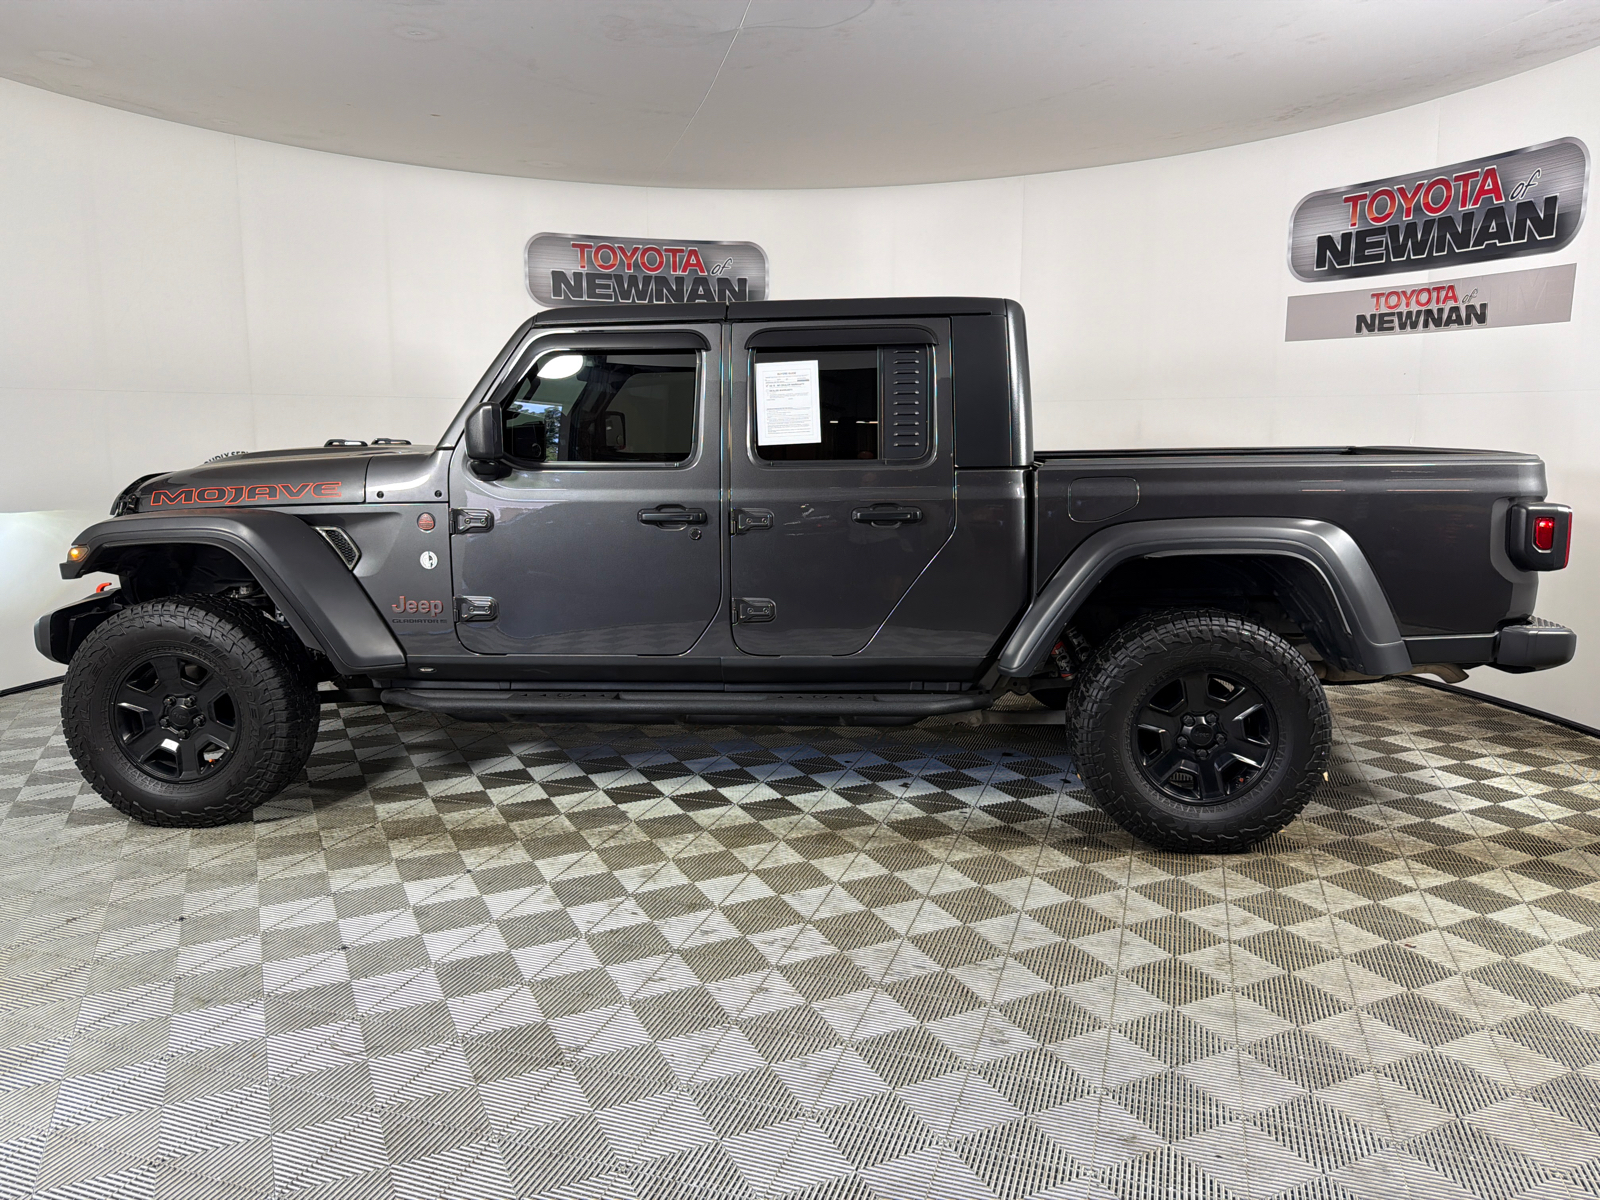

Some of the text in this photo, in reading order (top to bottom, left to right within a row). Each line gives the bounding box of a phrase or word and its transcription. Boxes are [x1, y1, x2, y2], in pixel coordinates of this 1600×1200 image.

[1343, 165, 1542, 228] TOYOTA of
[1314, 193, 1559, 271] NEWNAN
[570, 242, 733, 276] TOYOTA of
[550, 269, 749, 303] NEWNAN
[1370, 284, 1478, 311] TOYOTA of
[1354, 302, 1488, 335] NEWNAN
[150, 481, 342, 506] MOJAVE
[391, 595, 444, 618] Jeep
